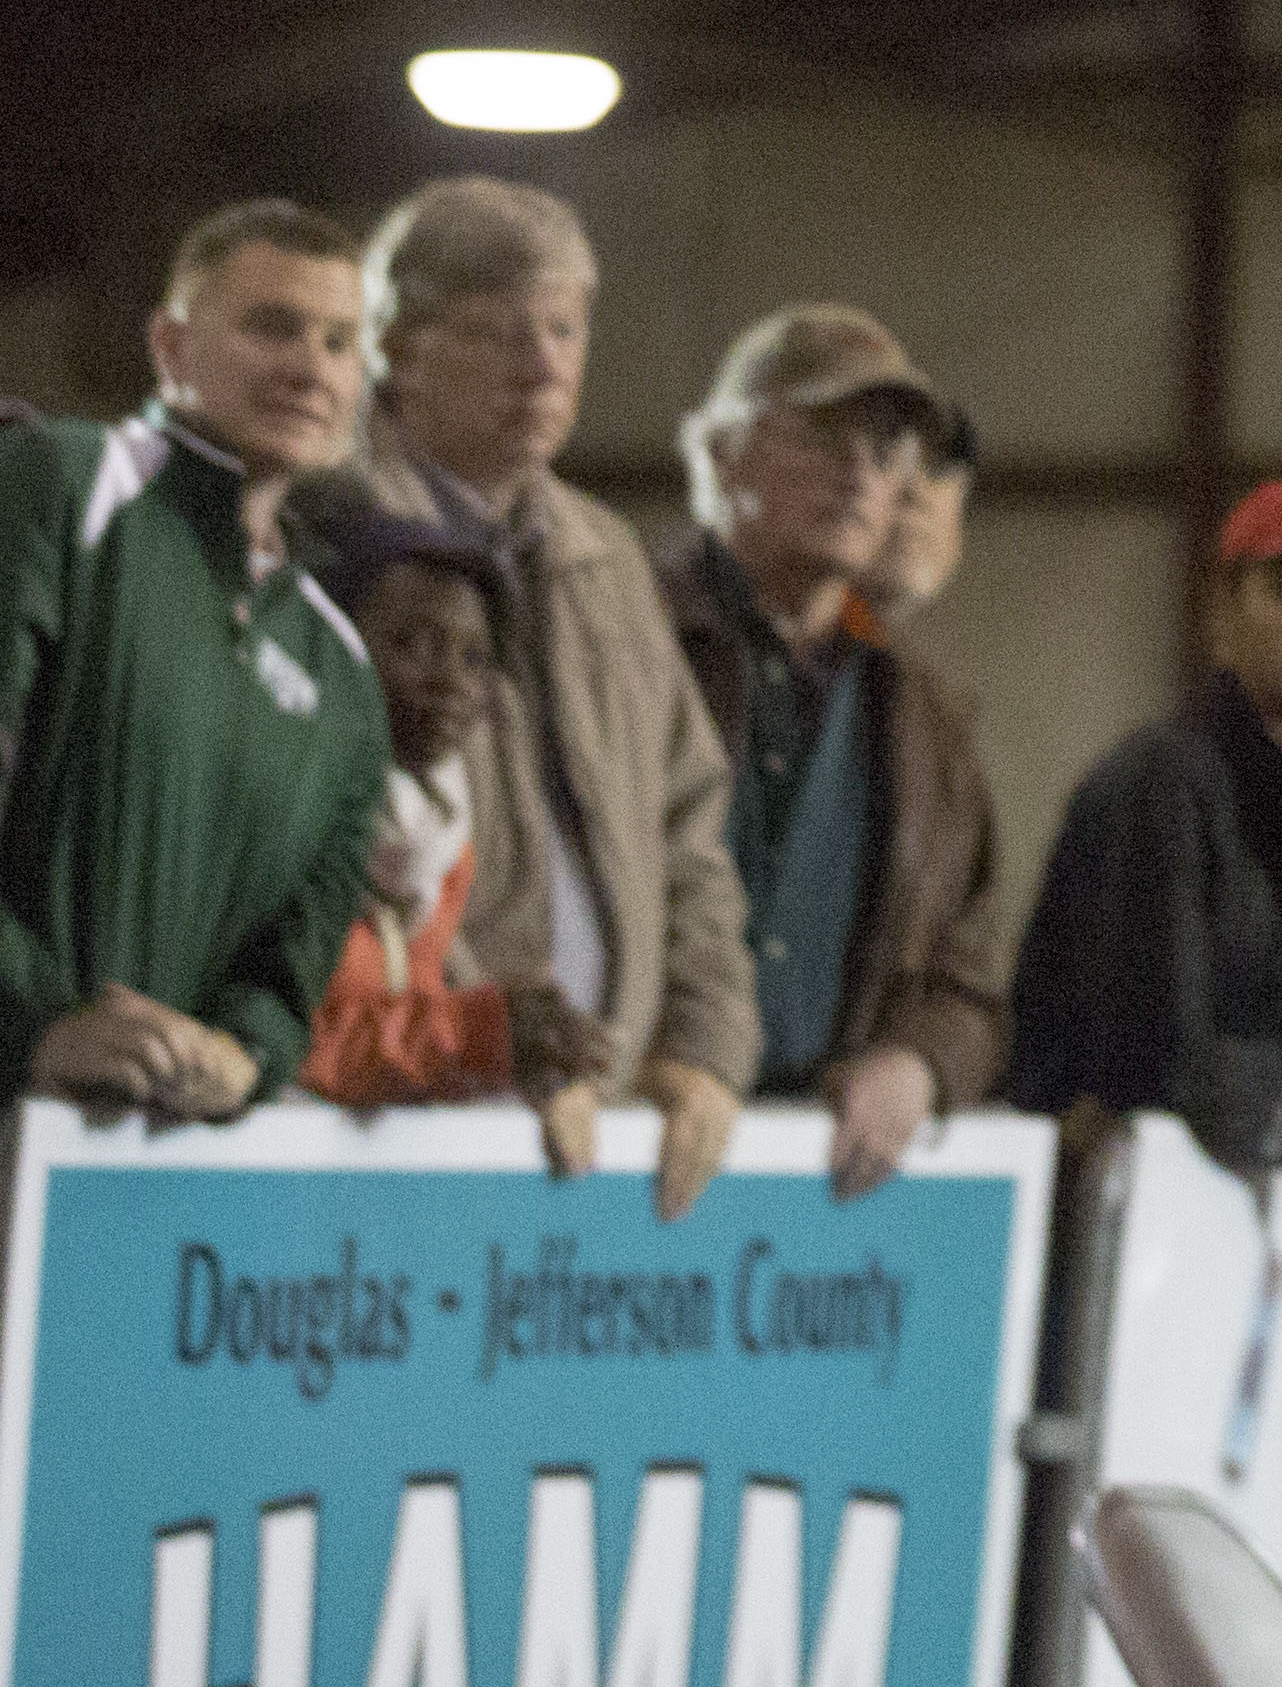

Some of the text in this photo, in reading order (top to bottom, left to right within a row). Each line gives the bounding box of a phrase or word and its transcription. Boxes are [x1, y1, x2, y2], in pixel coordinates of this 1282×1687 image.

[176, 1234, 907, 1399] Douglas Jefferson County
